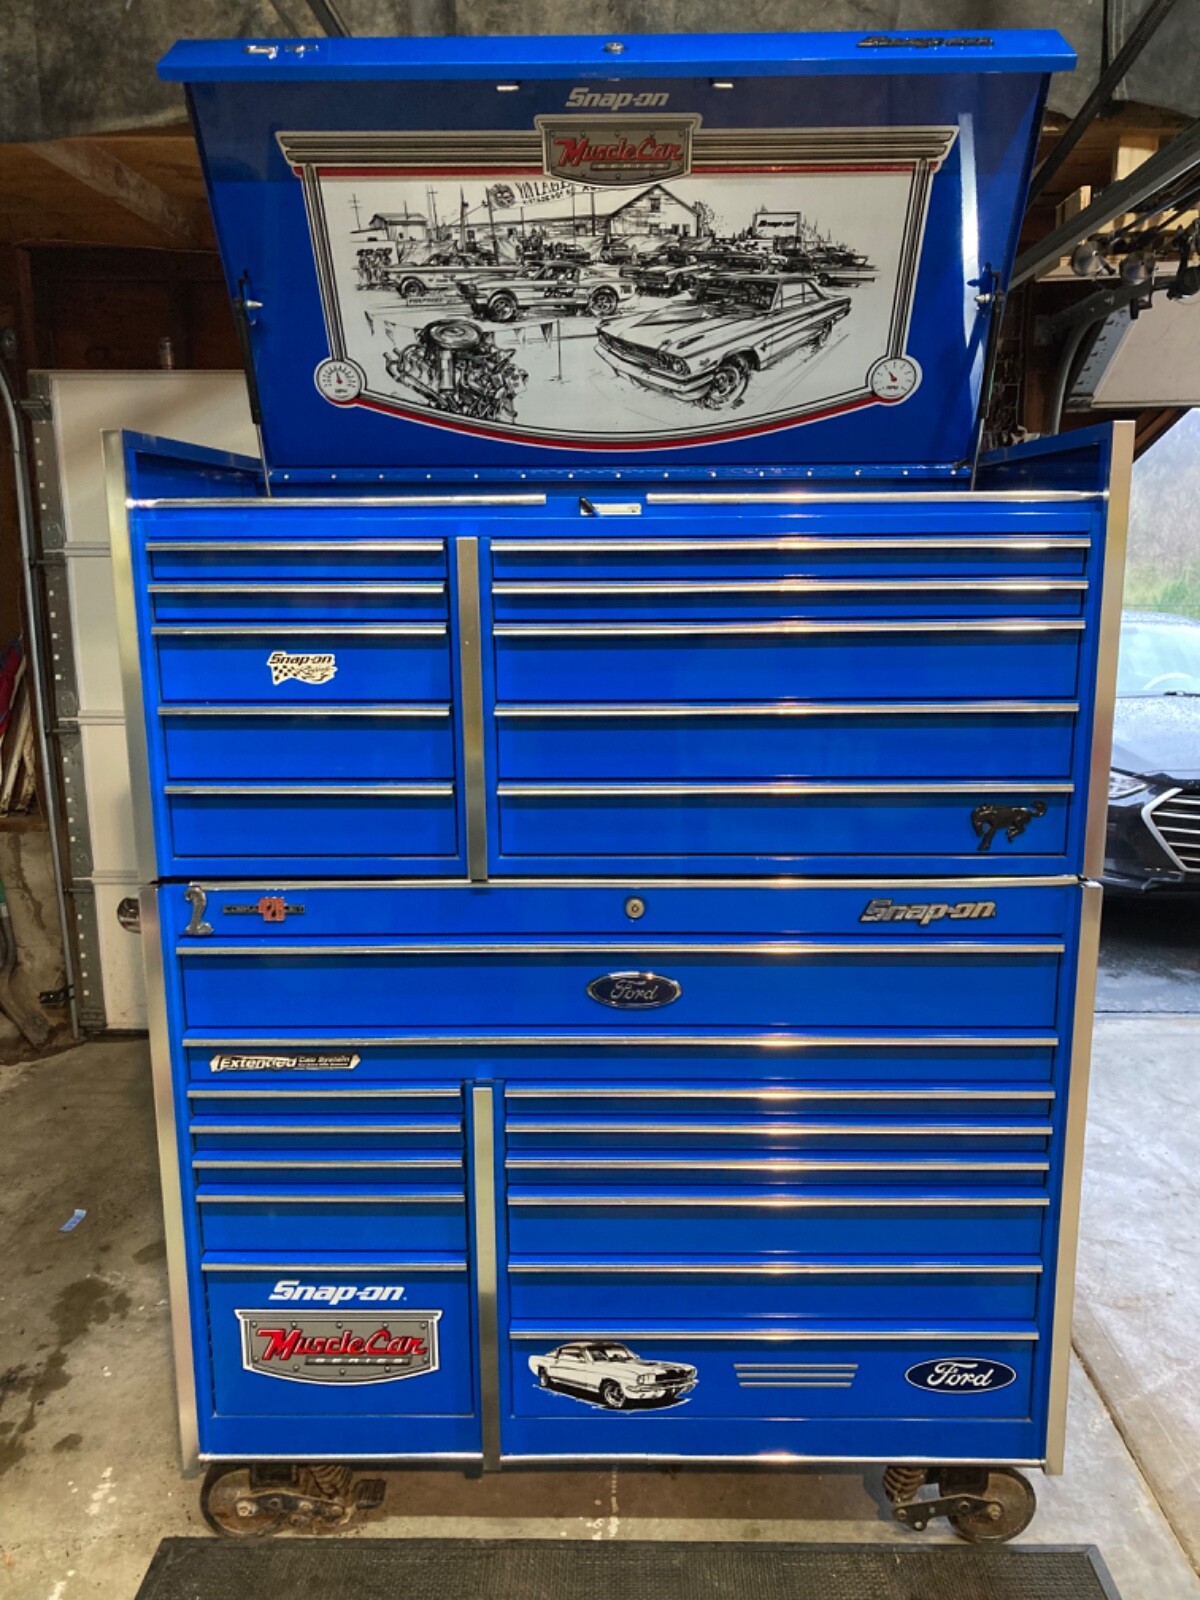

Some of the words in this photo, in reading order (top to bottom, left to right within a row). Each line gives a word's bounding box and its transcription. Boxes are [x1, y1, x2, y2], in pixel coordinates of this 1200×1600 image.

[564, 87, 670, 111] Snap-on
[269, 653, 332, 666] Snap-on
[860, 898, 996, 925] Snap-on
[610, 979, 660, 1000] Ford
[220, 1056, 297, 1069] Extended
[268, 1280, 406, 1305] Snap-on
[926, 1361, 995, 1387] Ford
